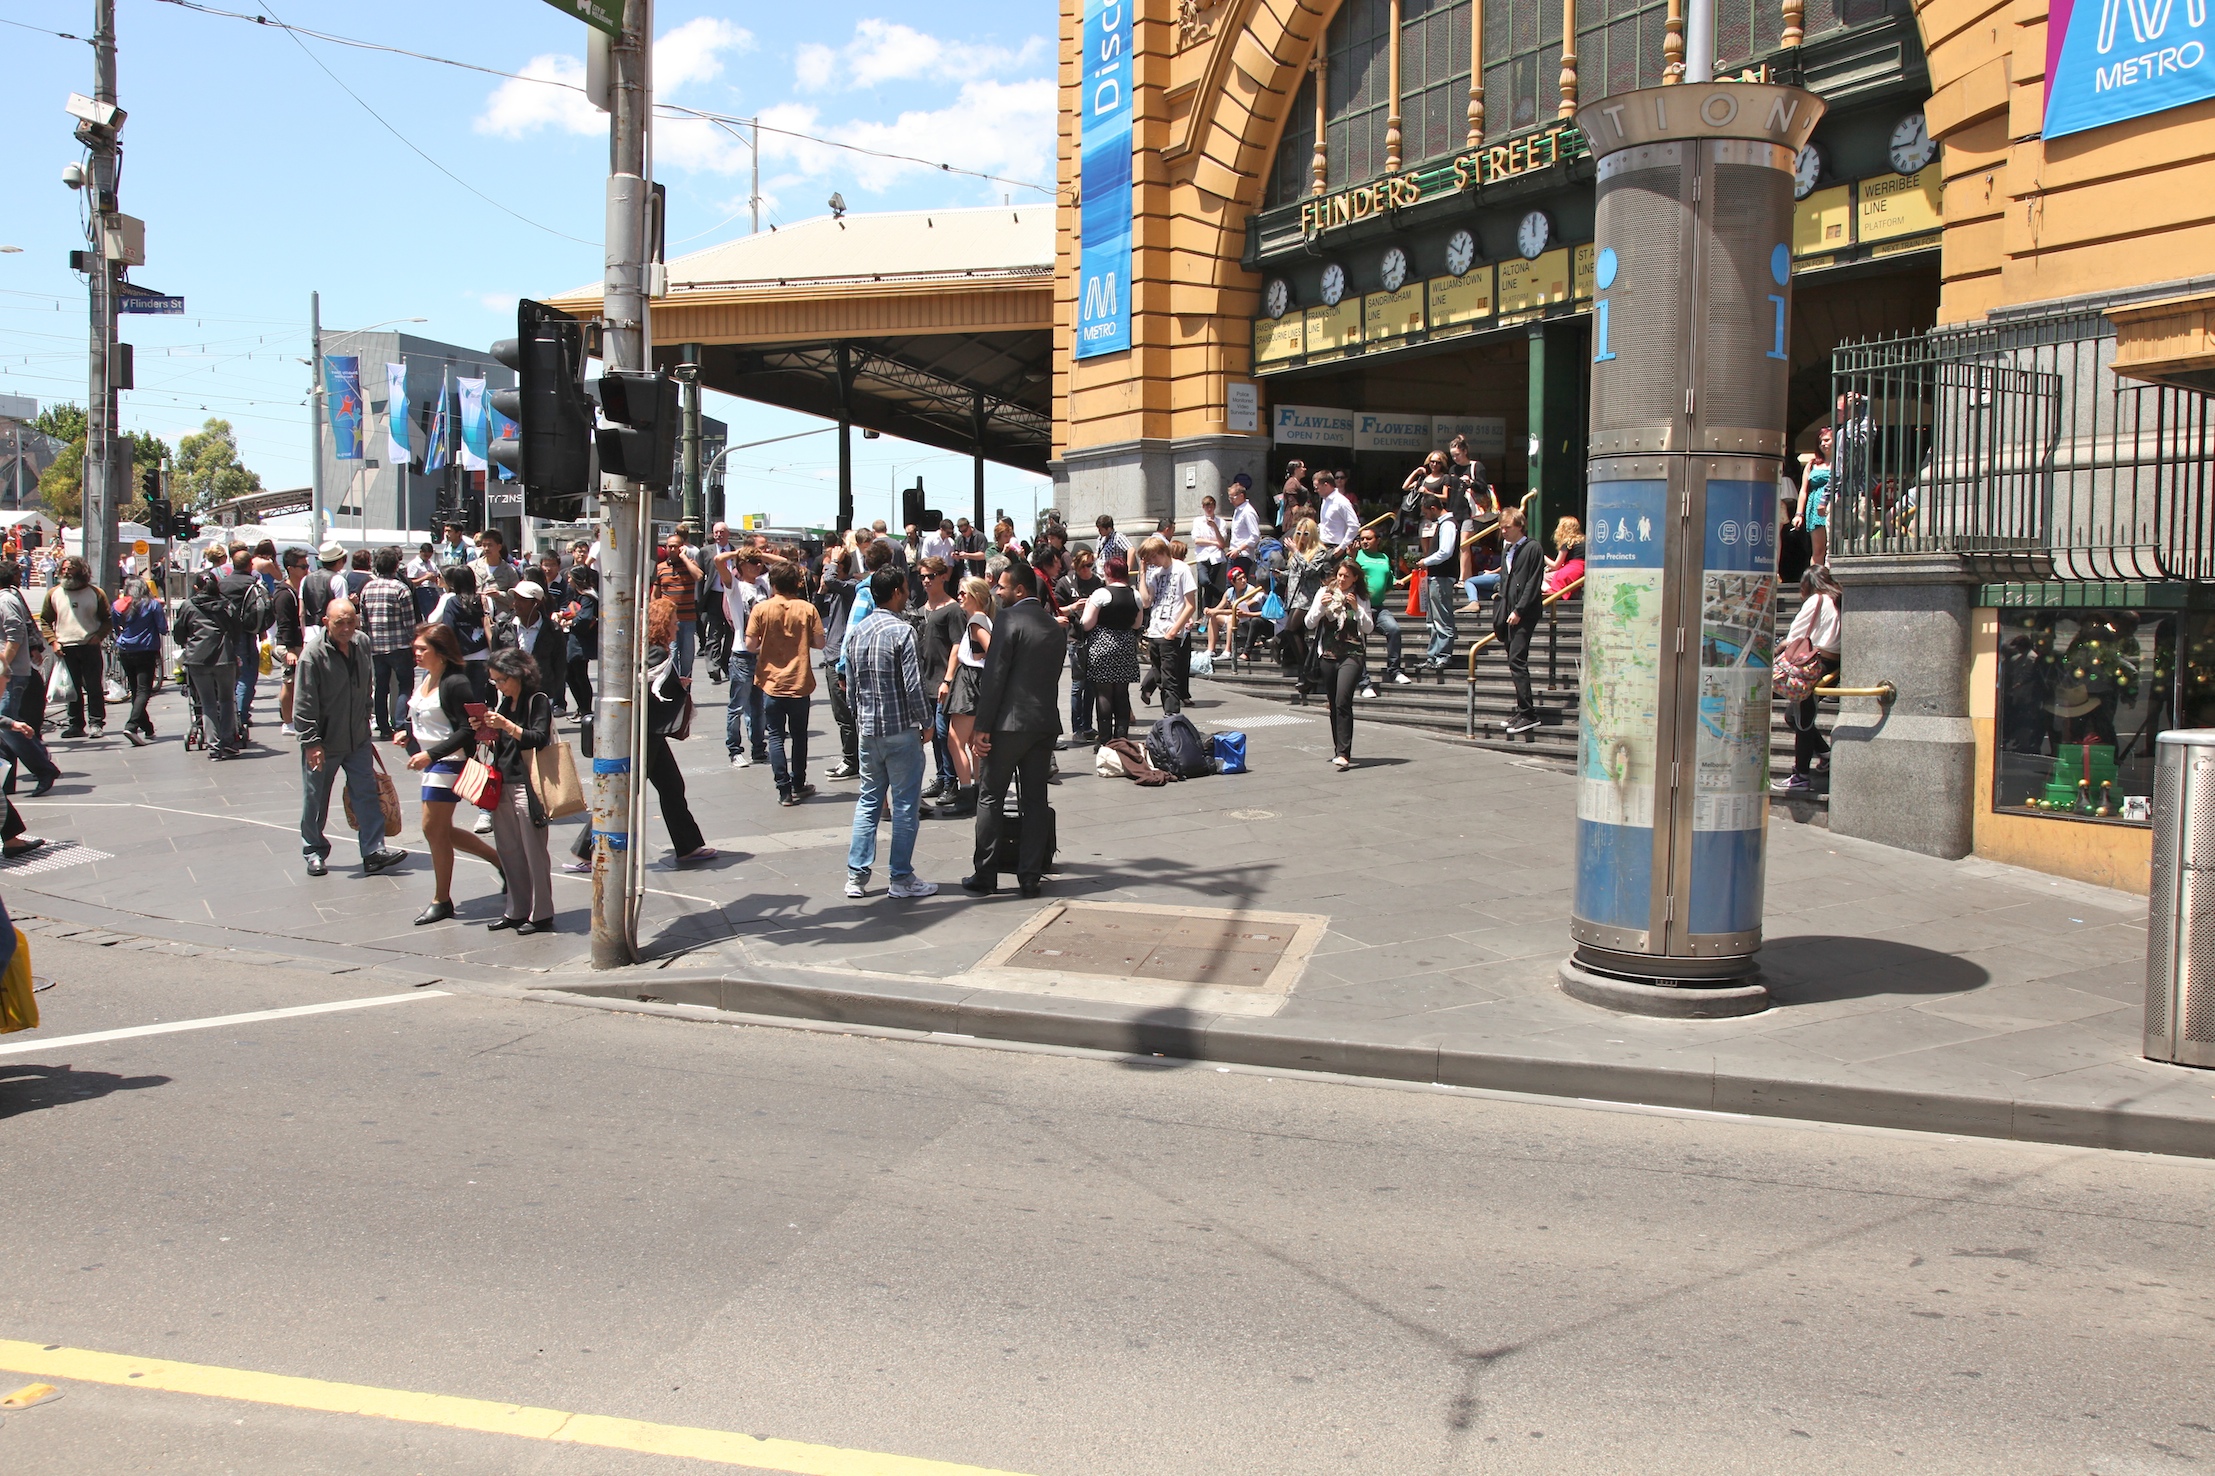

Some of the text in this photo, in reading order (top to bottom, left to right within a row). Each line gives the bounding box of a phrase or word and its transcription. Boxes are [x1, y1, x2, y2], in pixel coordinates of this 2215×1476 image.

[2095, 41, 2204, 93] METRO
[1301, 125, 1566, 233] FLINDERS STREET
[1864, 174, 1920, 198] WERRIBEE
[1864, 200, 1887, 216] LINE
[1864, 216, 1904, 231] PLATFORM
[1882, 236, 1936, 254] NEXT TRAIN FOR
[1502, 262, 1530, 276] ALTONA
[1578, 263, 1594, 276] LINE
[1432, 273, 1482, 292] WILLIAMSTOWN
[1502, 278, 1518, 291] LINE
[130, 298, 182, 308] Flinders St
[1368, 290, 1412, 308] SANDRINGHAM
[1432, 295, 1446, 306] LINE
[1502, 292, 1529, 304] PLATFORM
[1308, 307, 1340, 320] FRANKSTON
[1368, 310, 1381, 321] LINE
[1084, 322, 1116, 340] METRO
[1288, 328, 1301, 338] LINES
[1308, 323, 1320, 334] LINE
[1437, 424, 1452, 434] Ph:
[1476, 425, 1490, 434] 518
[1287, 430, 1344, 442] OPEN 7 DAYS
[1374, 438, 1420, 446] DELIVERIES
